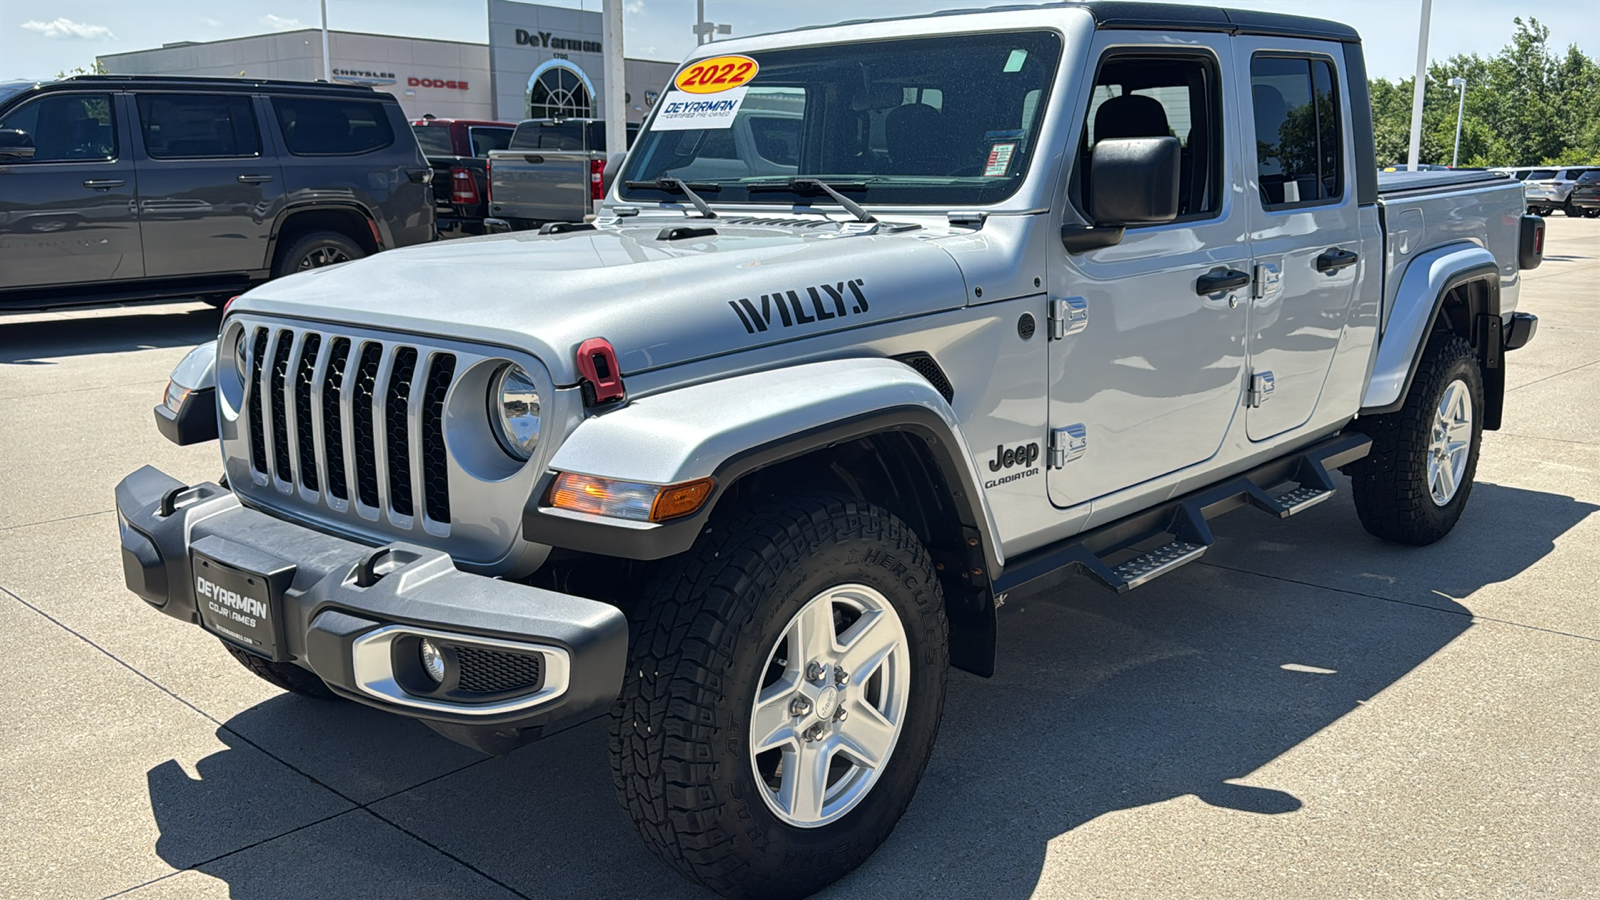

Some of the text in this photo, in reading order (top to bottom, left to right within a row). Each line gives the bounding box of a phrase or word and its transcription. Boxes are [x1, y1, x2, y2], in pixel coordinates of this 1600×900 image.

[515, 28, 602, 54] DeYarman
[332, 68, 396, 79] CHRYSLER
[407, 77, 469, 91] DODGE
[680, 62, 753, 87] 2022
[663, 99, 738, 114] DEYARMAN
[728, 278, 869, 334] WILLYS
[988, 442, 1039, 472] Jeep
[985, 467, 1039, 489] GLADIATOR
[197, 576, 267, 619] DEYARMAN
[862, 546, 939, 667] HERCULES
[231, 611, 257, 628] AMES
